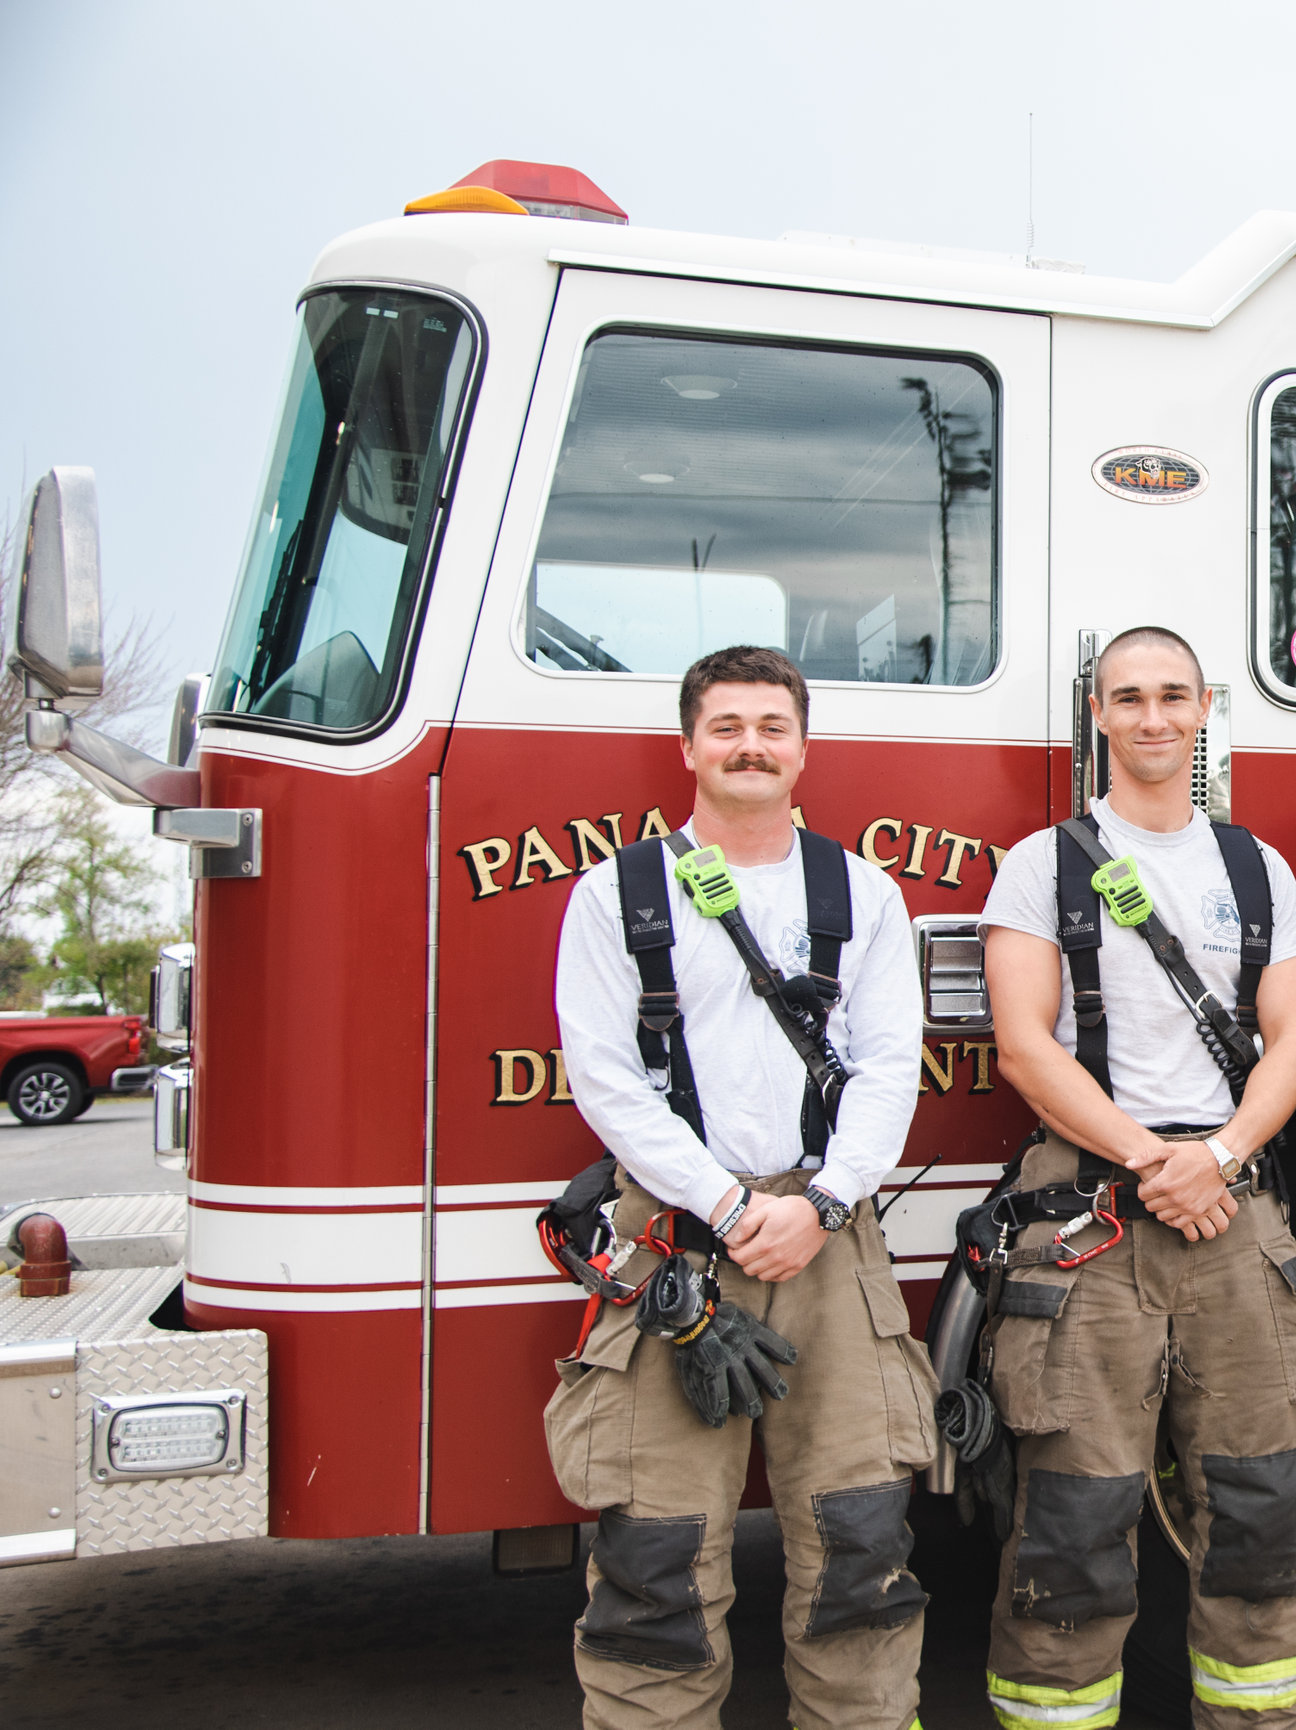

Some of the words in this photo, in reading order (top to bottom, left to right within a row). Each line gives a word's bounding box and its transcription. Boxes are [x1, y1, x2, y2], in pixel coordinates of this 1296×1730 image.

[1114, 466, 1188, 488] KME
[630, 919, 669, 931] VERIDIAN
[1062, 922, 1094, 933] VERIDIAN
[1244, 936, 1268, 944] VERIDIAN
[1203, 943, 1240, 954] FIREFIG
